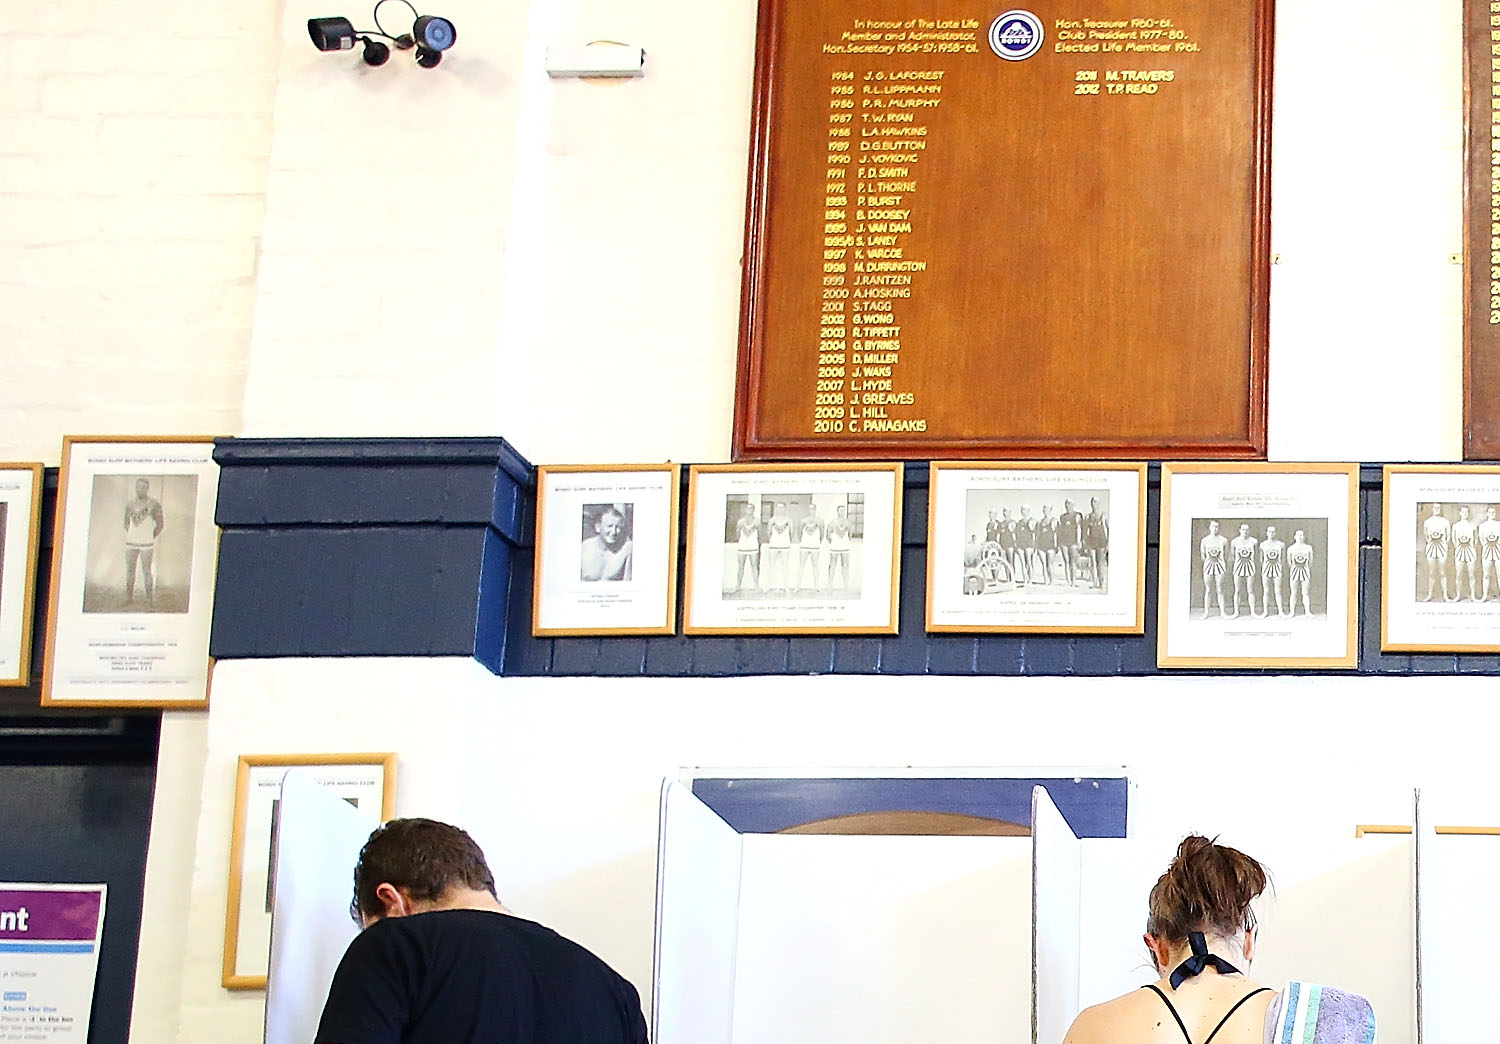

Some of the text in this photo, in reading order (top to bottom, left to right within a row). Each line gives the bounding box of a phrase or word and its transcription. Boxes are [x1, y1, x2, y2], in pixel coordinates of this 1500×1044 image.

[855, 19, 979, 28] In honour of The Late Life
[842, 32, 882, 40] Member
[885, 32, 905, 40] and
[1058, 31, 1086, 40] Club
[1055, 43, 1099, 53] Elected
[1103, 43, 1122, 52] Life
[1126, 43, 1171, 52] Member
[832, 71, 944, 80] 1984 LAFOREST
[1075, 71, 1098, 81] 2011
[1075, 84, 1099, 94] 2012
[824, 276, 845, 285] 1999
[823, 289, 849, 298] 2000
[822, 302, 844, 311] 2001
[817, 380, 844, 391] 2007
[815, 393, 844, 405] 2008
[863, 393, 914, 404] GREAVES
[814, 407, 888, 418] 2009 HILL
[814, 421, 843, 433] 2010
[864, 420, 927, 432] PANAGAKIS
